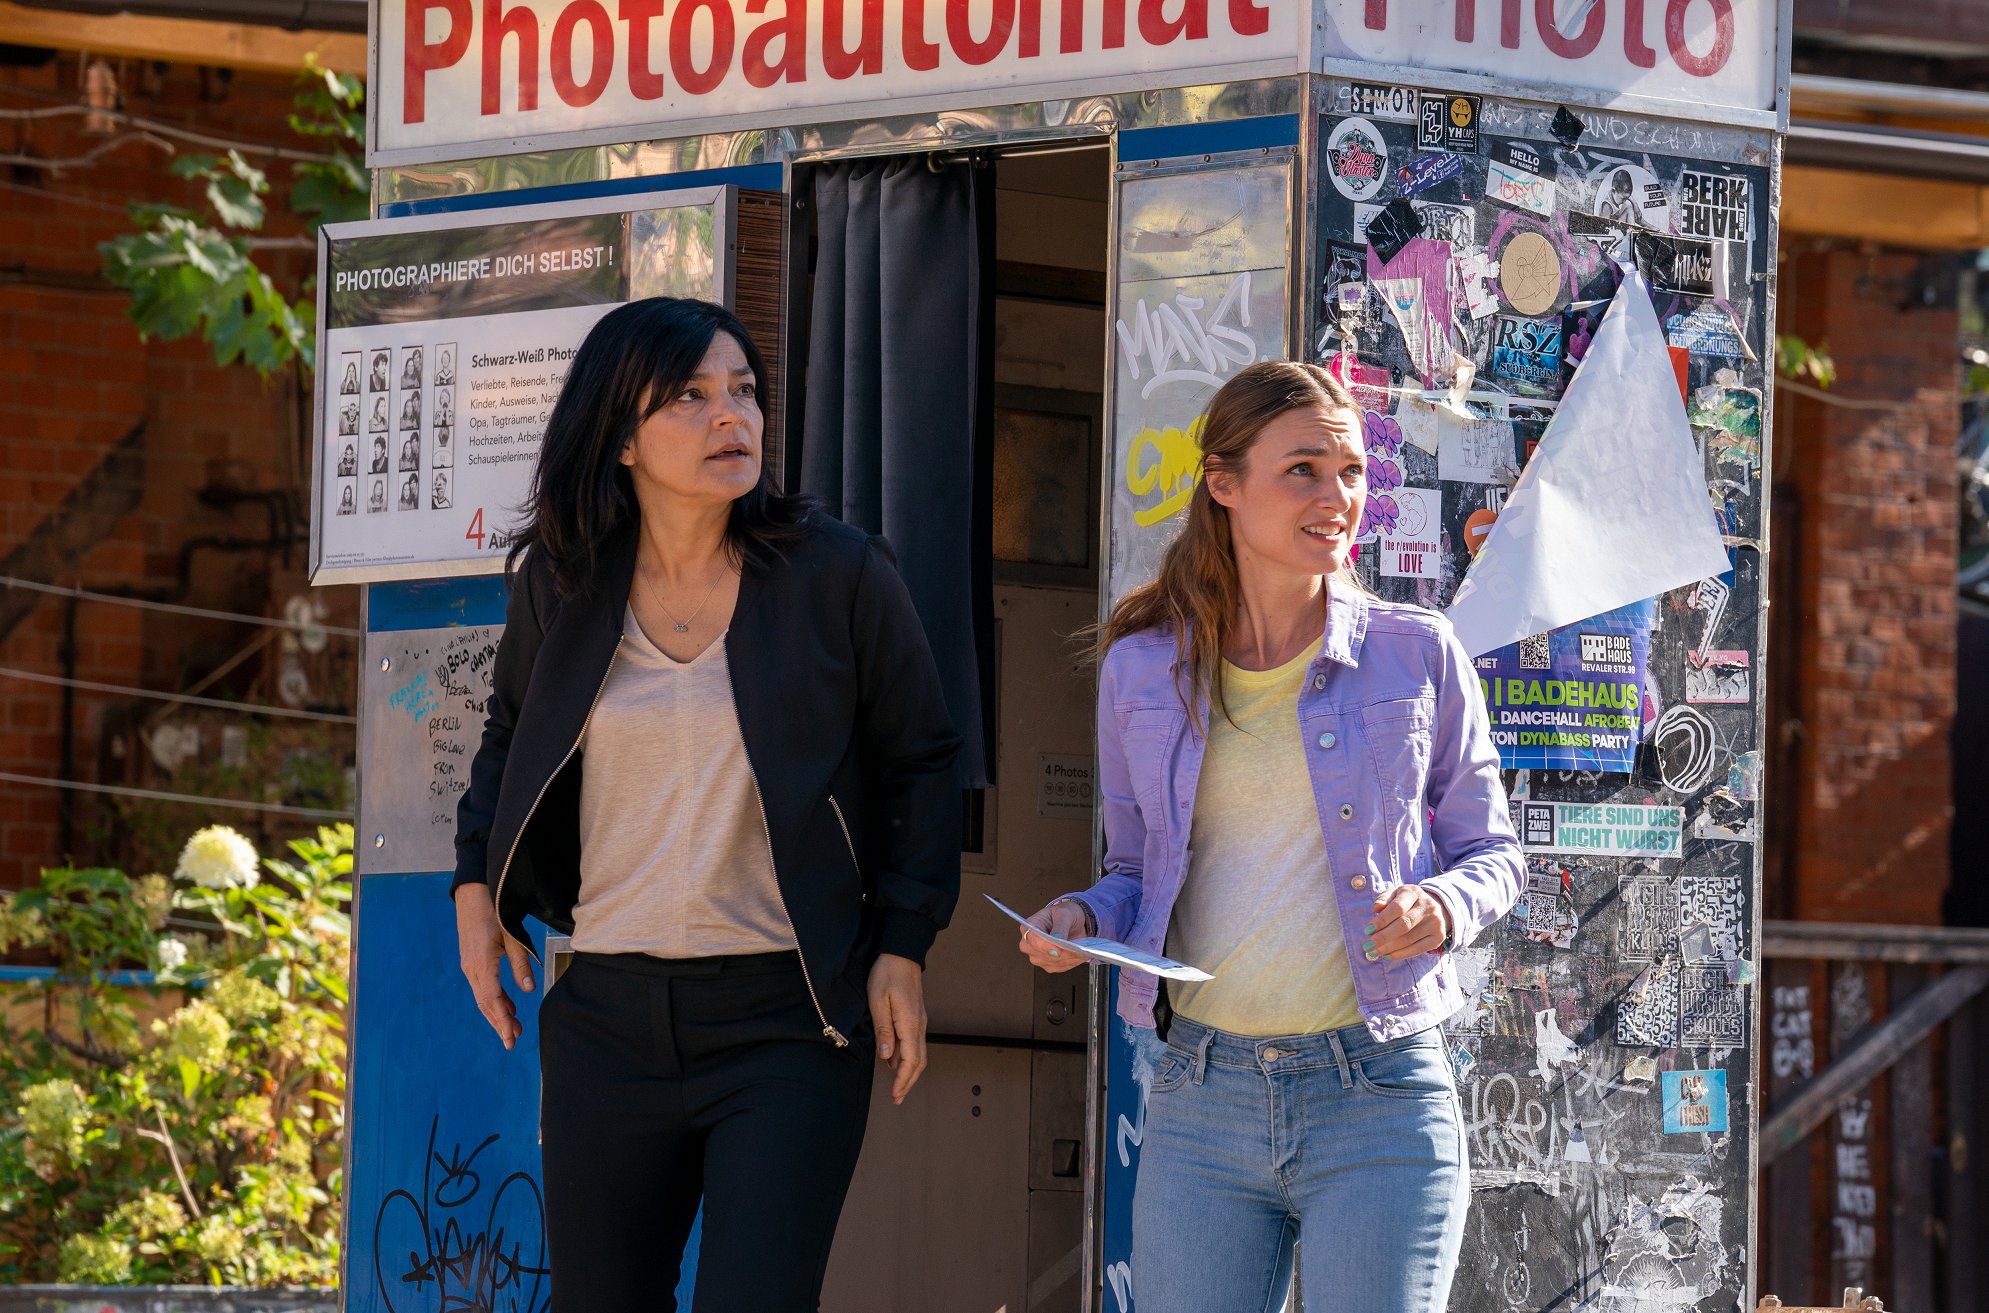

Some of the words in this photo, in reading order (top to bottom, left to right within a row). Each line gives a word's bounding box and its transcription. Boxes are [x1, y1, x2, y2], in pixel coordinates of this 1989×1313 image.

[1510, 149, 1540, 166] HELLO
[1518, 161, 1532, 171] NAME
[1682, 172, 1748, 209] BERK
[336, 257, 491, 292] PHOTOGRAPHIERE
[495, 253, 535, 278] DICH
[539, 246, 604, 273] SELBST
[1496, 318, 1559, 356] RSZ
[472, 348, 544, 368] Schwarz-Weiß
[471, 379, 508, 391] Verliebte,
[510, 375, 548, 389] Reisende,
[470, 398, 497, 410] Kinder,
[500, 395, 538, 408] Ausweise,
[470, 417, 489, 431] Opa,
[491, 414, 537, 429] Tagträumer,
[469, 434, 515, 446] Hochzeiten,
[466, 507, 486, 550] 4
[1385, 540, 1395, 551] the
[1397, 541, 1429, 552] r/evolution
[1431, 542, 1437, 553] is
[1398, 553, 1423, 574] LOVE
[1607, 636, 1631, 650] BADE
[1607, 650, 1632, 664] HAUS
[1582, 663, 1612, 673] REVALER
[1613, 665, 1636, 675] STR.99
[1508, 679, 1639, 711] BADEHAUS
[1501, 710, 1582, 727] DANCEHALL
[1520, 731, 1591, 748] DYNABASS
[1592, 735, 1630, 749] PARTY
[1045, 764, 1051, 776] 4
[1054, 764, 1089, 778] Photos
[1528, 808, 1550, 820] PETA
[1558, 805, 1601, 824] TIERE
[1606, 807, 1644, 826] SIND
[1648, 808, 1680, 828] UNS
[1528, 819, 1550, 831] ZWEI
[1558, 827, 1612, 849] NICHT
[1615, 829, 1680, 851] WURST
